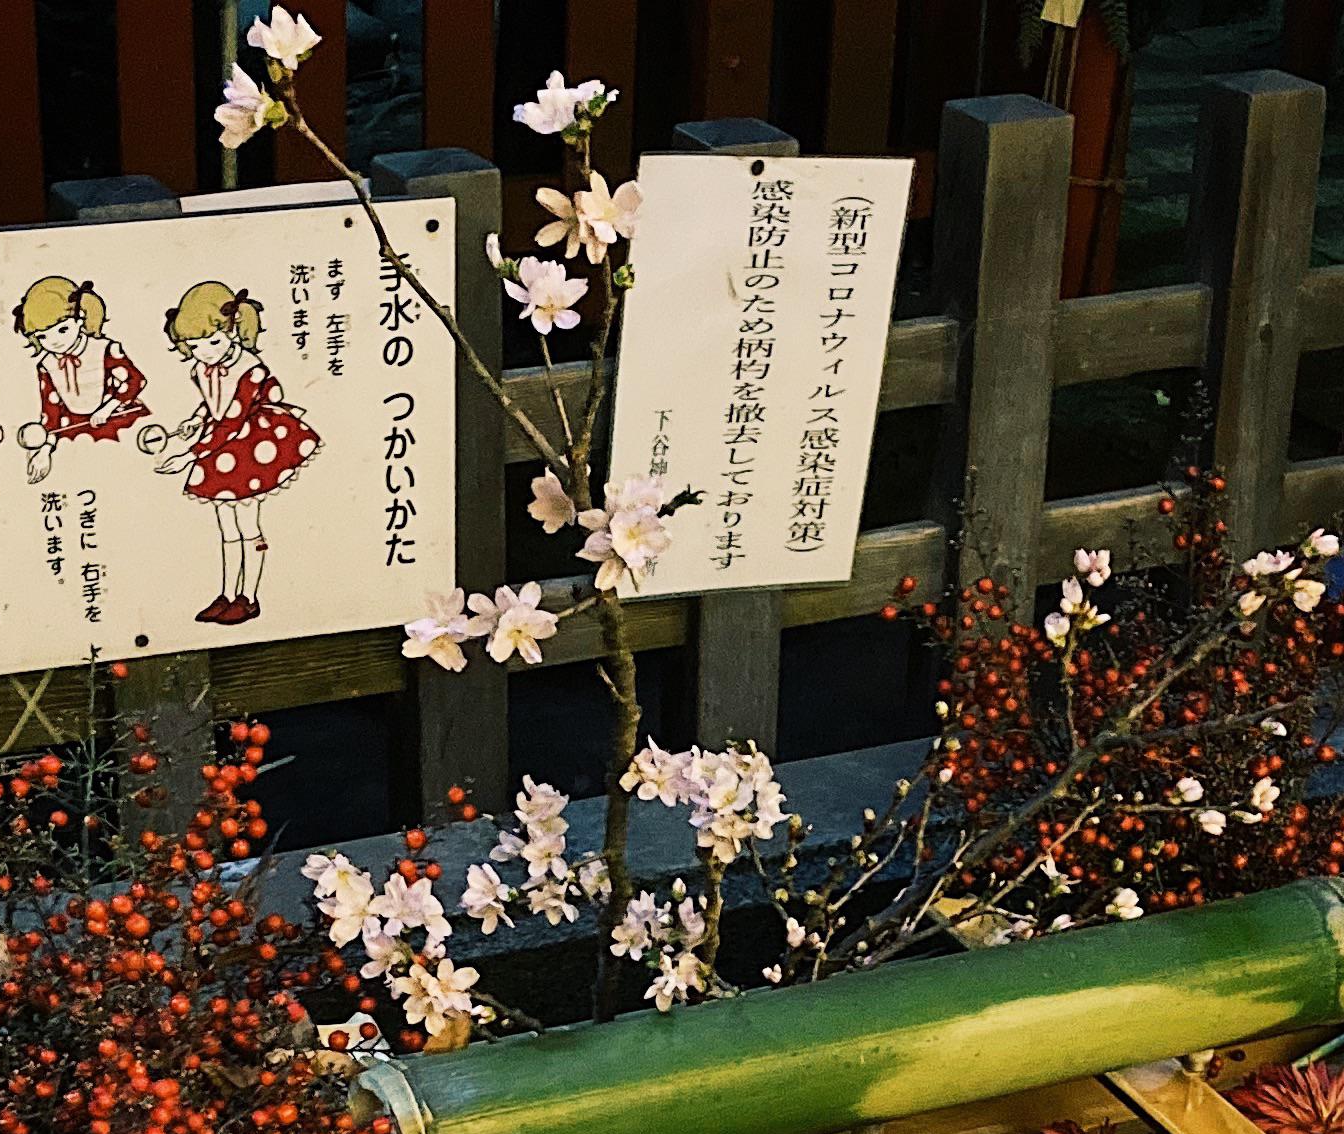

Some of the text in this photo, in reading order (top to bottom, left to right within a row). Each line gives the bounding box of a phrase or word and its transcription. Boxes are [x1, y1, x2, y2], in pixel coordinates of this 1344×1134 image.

[290, 264, 310, 360] 洗います。
[325, 258, 346, 376] まず 左手を
[709, 179, 795, 571] 感染防止のため柄杓を撤去しております
[41, 492, 65, 585] 洗います。
[383, 392, 418, 567] つかいかた
[77, 489, 102, 622] つきに 右手を
